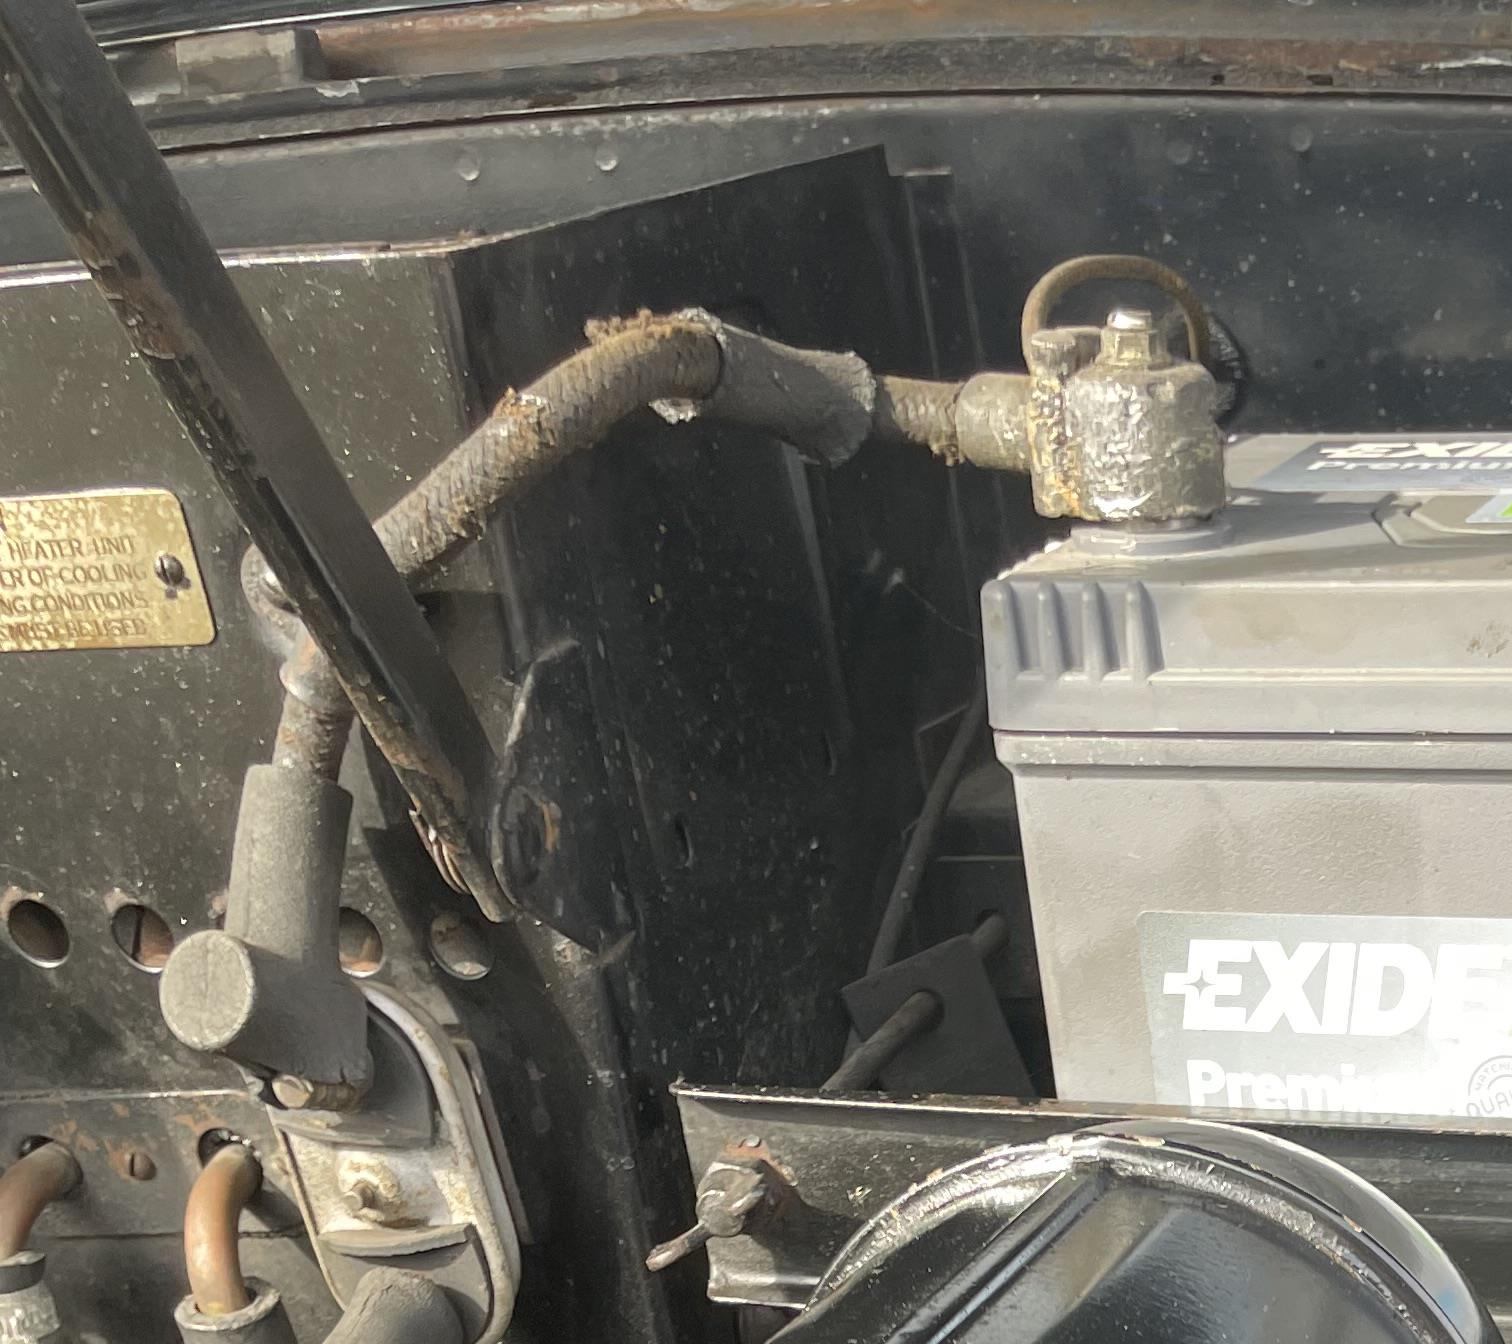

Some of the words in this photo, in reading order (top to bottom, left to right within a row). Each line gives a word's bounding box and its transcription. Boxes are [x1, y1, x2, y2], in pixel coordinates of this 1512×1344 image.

[58, 562, 148, 585] COOLING
[30, 591, 149, 614] CONDITIONS
[1163, 938, 1508, 1037] EXIDE
